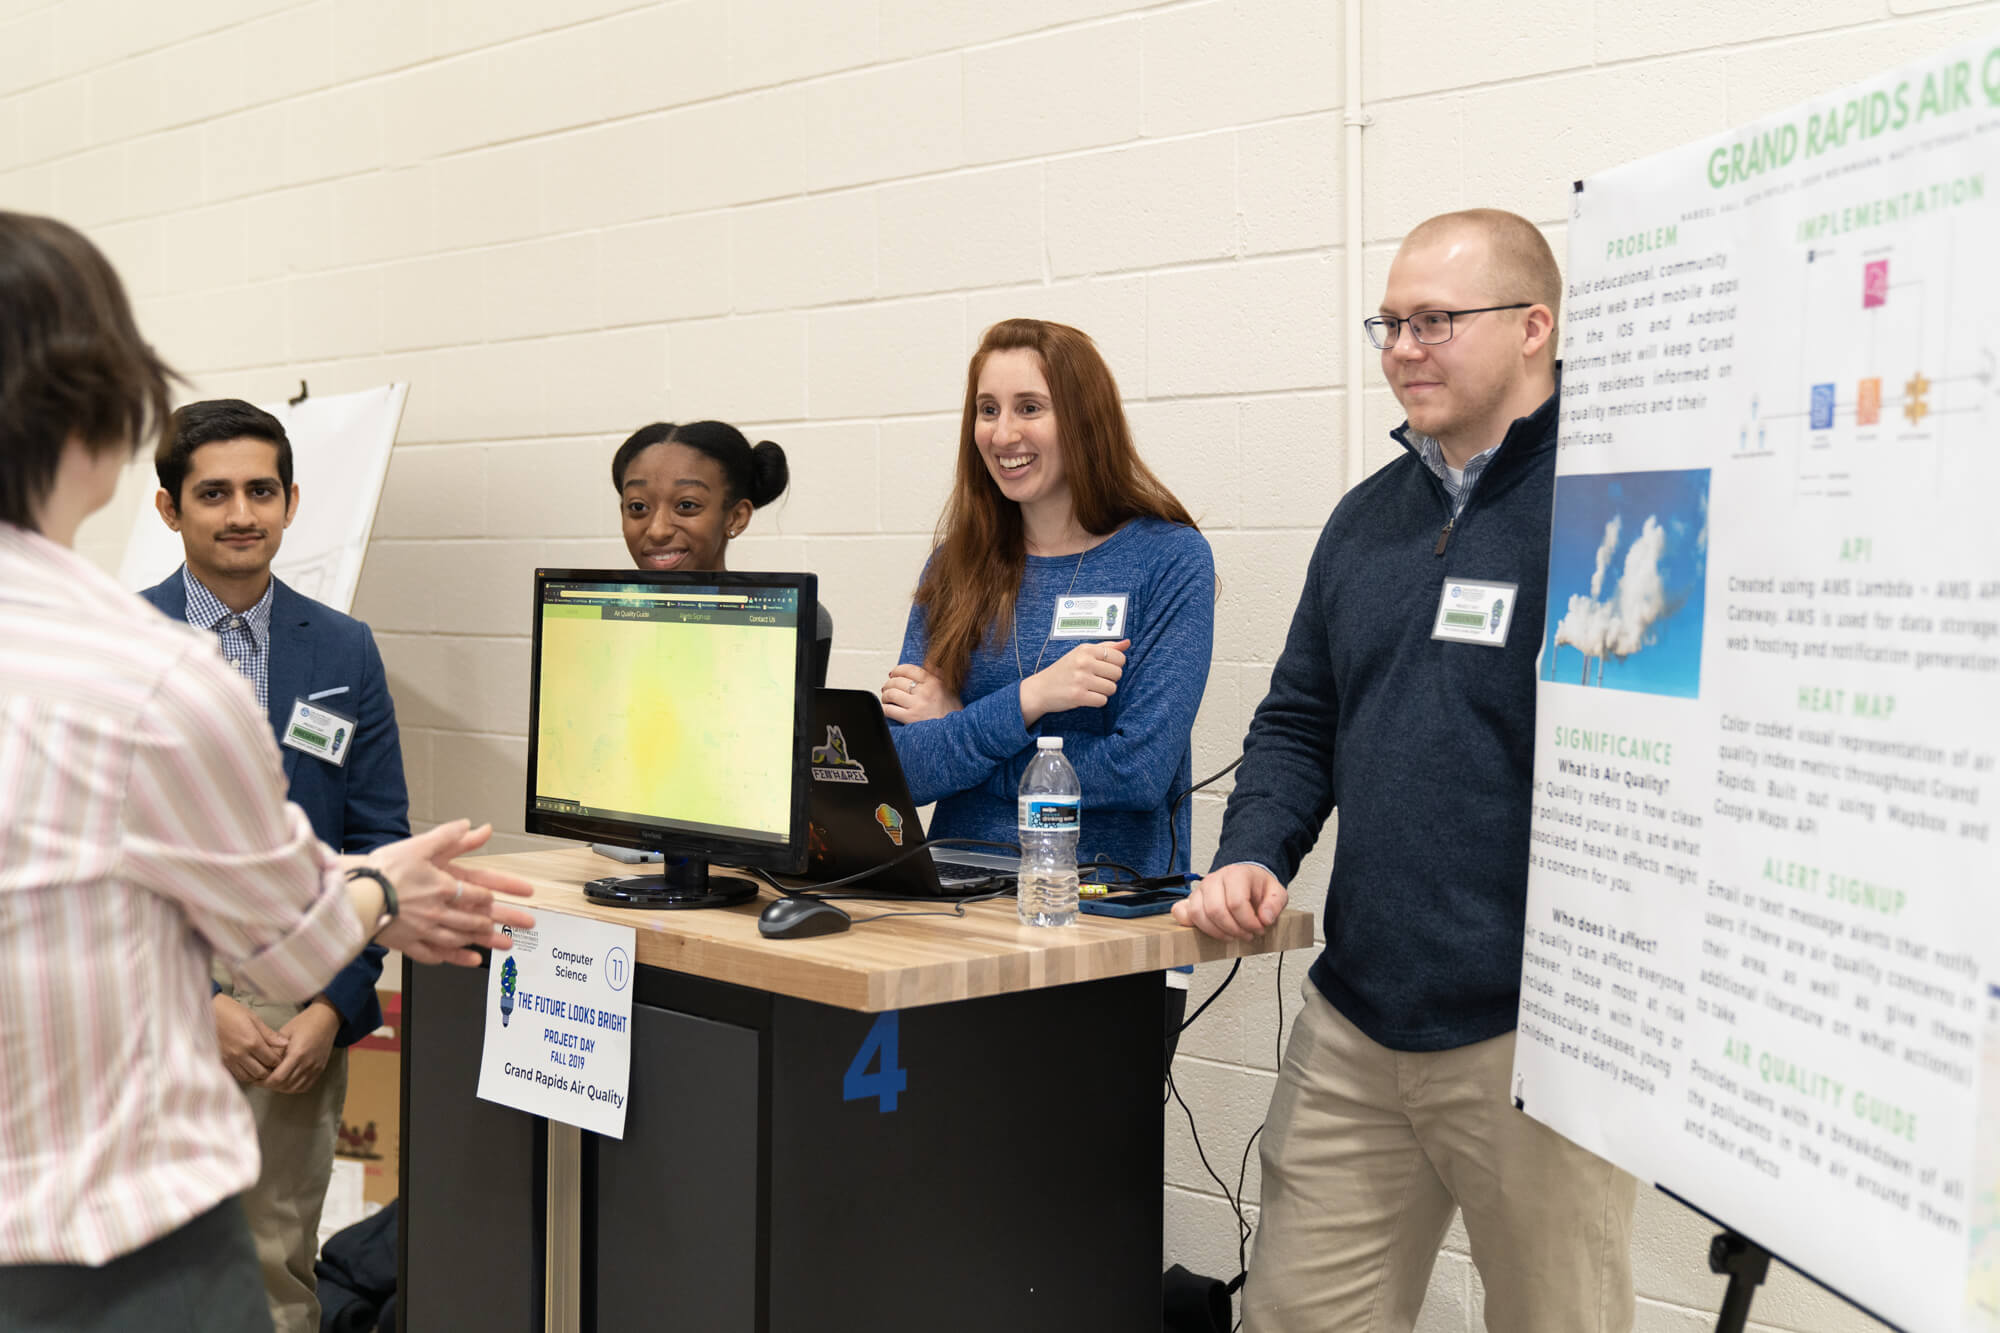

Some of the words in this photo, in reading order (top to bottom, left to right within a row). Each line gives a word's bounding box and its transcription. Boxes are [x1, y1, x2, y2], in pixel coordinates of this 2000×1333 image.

[1708, 122, 1797, 189] GRAND
[1805, 81, 1909, 159] RAPIDS
[1915, 61, 1971, 124] AIR
[1797, 174, 1985, 244] IMPLEMENTATION
[1606, 225, 1678, 261] PROBLEM
[1594, 265, 1655, 292] educational
[1659, 253, 1727, 278] community
[1568, 303, 1601, 322] ocused
[1607, 299, 1627, 314] web
[1633, 291, 1654, 309] and
[1662, 283, 1702, 303] mobile
[1711, 278, 1738, 297] apps
[1586, 330, 1603, 344] the
[1649, 315, 1670, 333] and
[1687, 304, 1737, 326] Android
[1611, 350, 1632, 365] that
[1637, 343, 1657, 360] will
[1664, 342, 1692, 359] keep
[1699, 332, 1733, 352] Grand
[1598, 375, 1644, 392] residents
[1653, 364, 1709, 384] informed
[1570, 404, 1605, 422] quality
[1608, 402, 1647, 417] metrics
[1650, 395, 1672, 413] and
[1839, 536, 1872, 563] API
[1728, 574, 1775, 595] Created
[1780, 578, 1815, 600] using
[1821, 578, 1851, 596] AWS
[1857, 579, 1913, 599] Lambda
[1934, 580, 1971, 600] AWS
[1785, 607, 1815, 627] AWS
[1837, 610, 1867, 630] used
[1873, 610, 1893, 631] for
[1900, 613, 1933, 633] data
[1727, 634, 1748, 652] web
[1752, 635, 1799, 658] hosting
[1803, 639, 1827, 658] and
[1831, 641, 1910, 665] notification
[1798, 685, 1845, 715] HEAT
[1852, 692, 1896, 720] MAP
[1554, 725, 1672, 766] SIGNIFICANCE
[1720, 713, 1750, 734] Color
[1754, 720, 1792, 742] coded
[1797, 726, 1835, 747] visual
[1838, 733, 1946, 765] representation
[1558, 758, 1587, 777] What
[1590, 763, 1600, 779] is
[1604, 767, 1620, 783] Air
[1624, 770, 1670, 796] Quality?
[1718, 744, 1757, 768] quality
[1762, 751, 1796, 771] index
[1800, 758, 1841, 780] metric
[1844, 765, 1927, 796] throughout
[1931, 778, 1980, 806] Grand
[1546, 781, 1583, 805] Quality
[1589, 792, 1621, 810] refers
[1626, 798, 1637, 813] to
[1642, 801, 1666, 820] how
[1672, 809, 1703, 828] clean
[1757, 806, 1789, 832] Maps
[1540, 806, 1582, 828] polluted
[1585, 818, 1611, 833] your
[1615, 823, 1628, 838] air
[1647, 832, 1668, 848] and
[1547, 858, 1588, 880] concern
[1592, 868, 1608, 884] for
[1582, 840, 1618, 862] health
[1623, 851, 1659, 874] effects
[1664, 863, 1698, 885] might
[1763, 857, 1820, 893] ALERT
[1826, 872, 1906, 915] SIGNUP
[1552, 907, 1575, 928] Who
[1578, 916, 1604, 937] does
[1608, 924, 1617, 940] it
[1620, 931, 1658, 955] affect?
[1705, 911, 1734, 934] users
[1750, 923, 1781, 948] there
[1785, 937, 1805, 956] are
[1708, 879, 1739, 904] Email
[1743, 892, 1755, 908] or
[1759, 896, 1784, 918] text
[1789, 906, 1844, 938] message
[1849, 924, 1891, 950] alerts
[1895, 935, 1928, 961] that
[551, 947, 593, 967] Computer
[613, 959, 623, 982] 11
[1538, 931, 1573, 956] quality
[1577, 944, 1598, 961] can
[1602, 951, 1634, 974] affect
[555, 965, 588, 983] Science
[1571, 967, 1602, 990] those
[1611, 982, 1638, 1004] most
[1700, 968, 1757, 1001] additional
[518, 991, 534, 1010] THE
[535, 996, 566, 1018] FUTURE
[568, 1003, 595, 1026] LOOKS
[598, 1010, 627, 1033] BRIGHT
[1521, 997, 1588, 1036] cardiovascular
[1564, 991, 1601, 1016] people
[544, 1028, 578, 1049] PROJECT
[580, 1036, 595, 1053] DAY
[550, 1050, 567, 1066] FALL
[568, 1054, 585, 1070] 2019
[842, 1009, 907, 1112] 4
[1559, 1041, 1579, 1060] and
[1582, 1051, 1620, 1081] elderly
[1622, 1068, 1656, 1096] people
[504, 1062, 533, 1082] Grand
[535, 1070, 568, 1091] Rapids
[570, 1078, 585, 1096] Air
[587, 1084, 625, 1109] Quality
[1723, 1036, 1751, 1069] AIR
[1759, 1051, 1845, 1106] QUALITY
[1853, 1090, 1918, 1143] GUIDE
[1684, 1116, 1704, 1140] and
[1708, 1127, 1735, 1154] their
[1687, 1087, 1705, 1110] the
[1711, 1100, 1773, 1143] pollutants
[1798, 1143, 1821, 1168] the
[1690, 1057, 1737, 1095] Provides
[1743, 1086, 1775, 1113] users
[1829, 1124, 1913, 1177] breakdown
